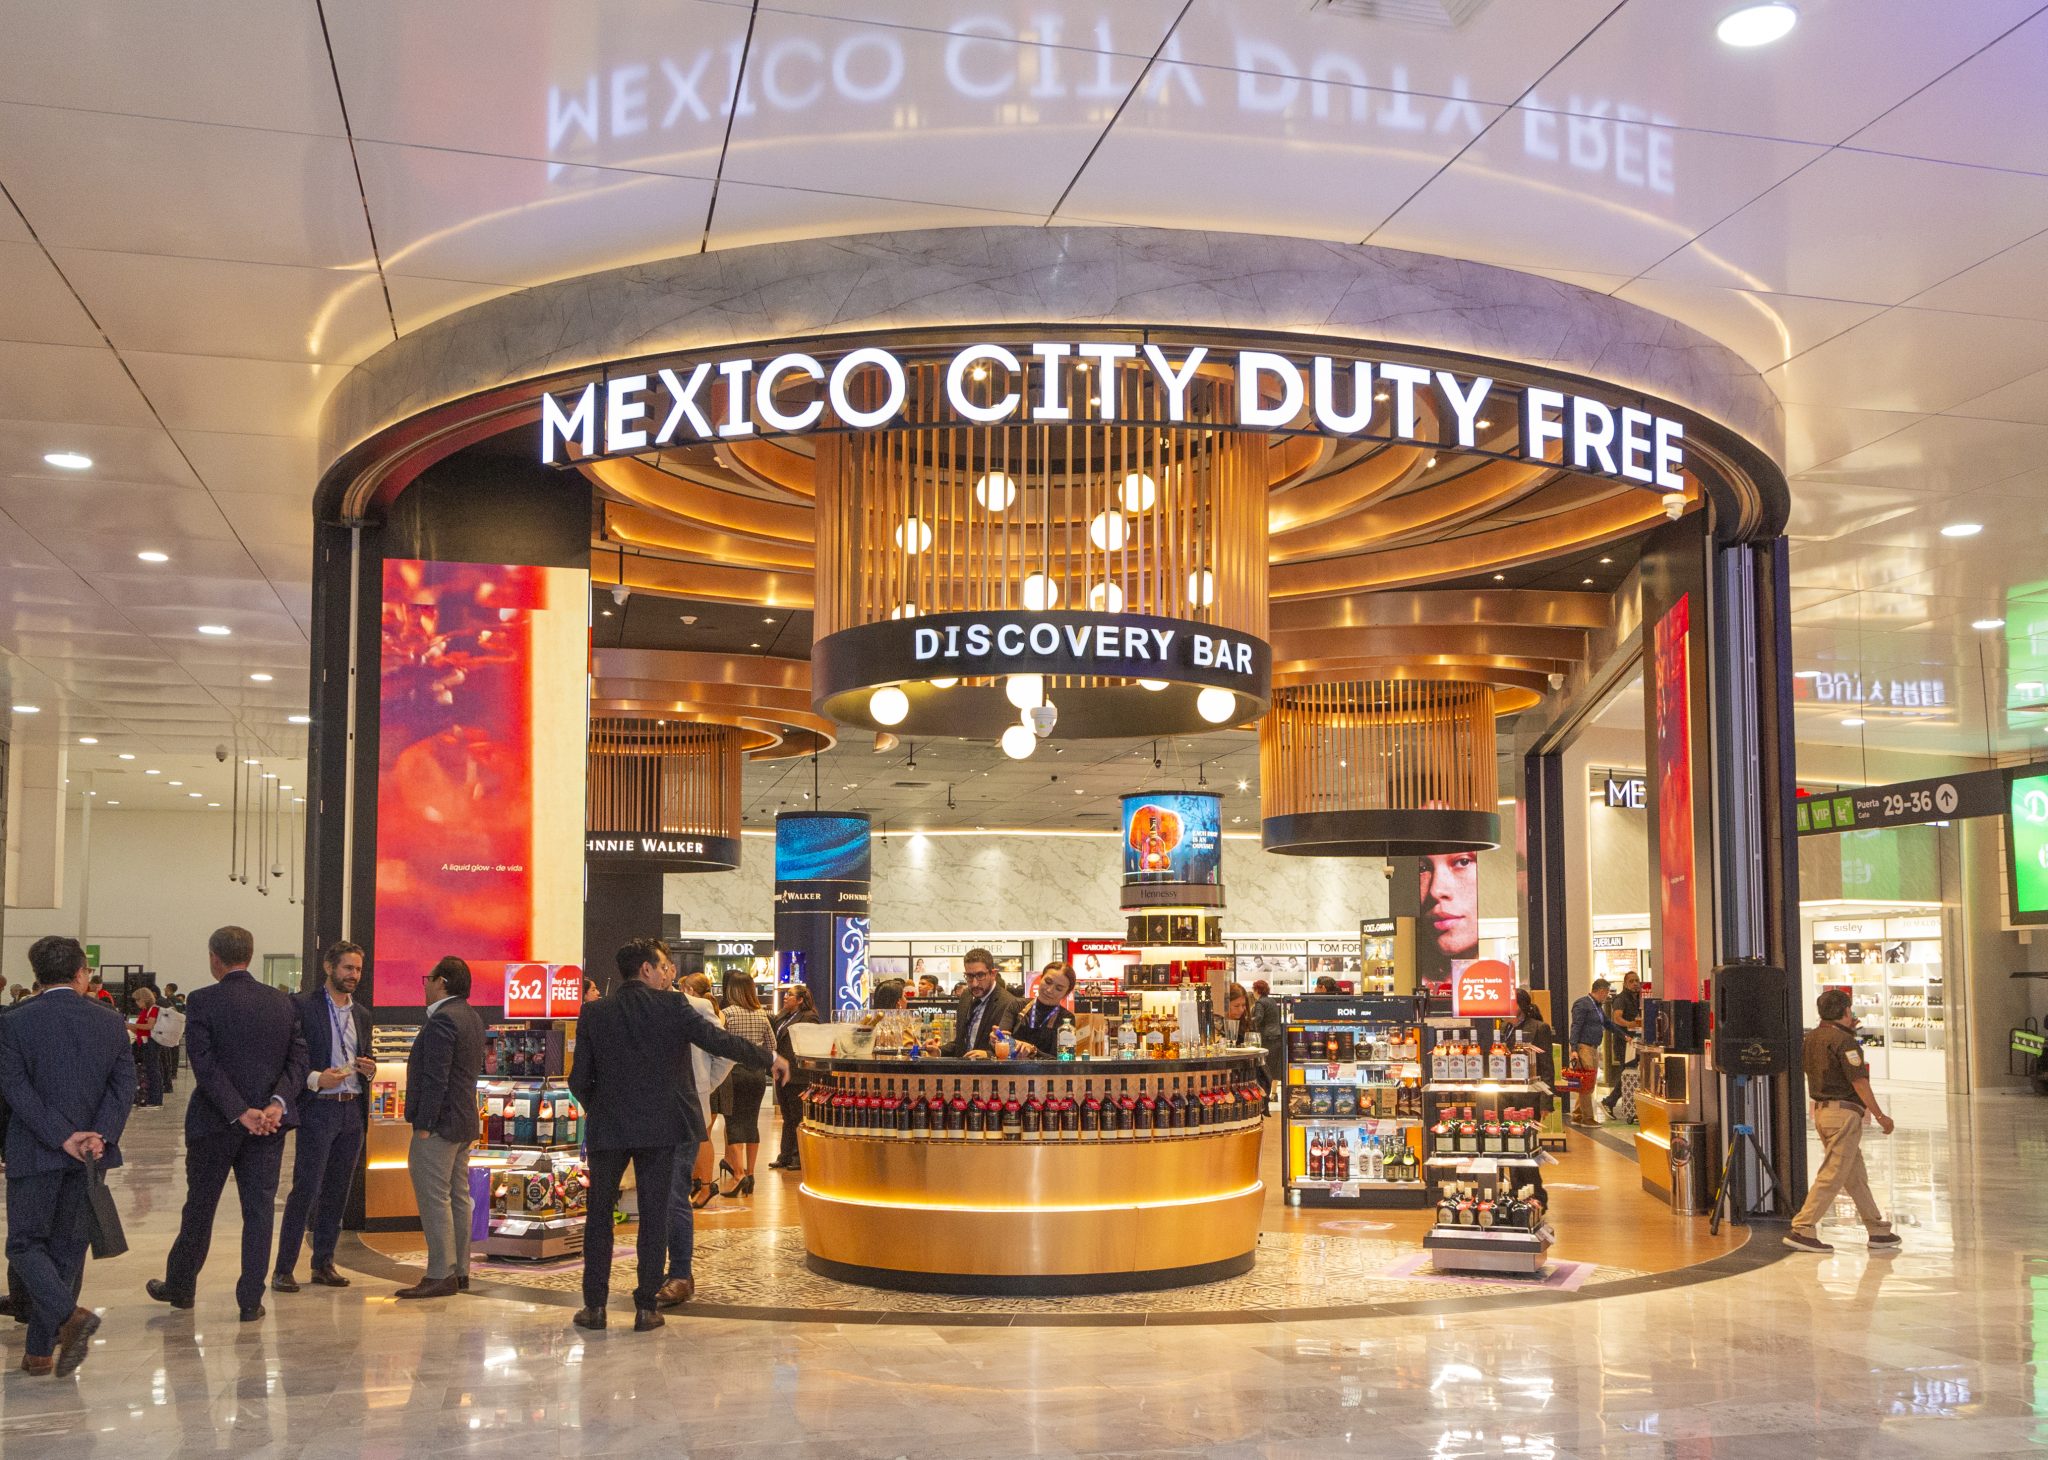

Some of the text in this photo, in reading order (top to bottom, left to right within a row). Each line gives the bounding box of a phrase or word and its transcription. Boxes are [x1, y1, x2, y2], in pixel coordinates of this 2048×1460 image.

[541, 342, 1685, 492] MEXICO CITY DUTY FREE
[915, 622, 1254, 676] DISCOVERY BAR
[1813, 790, 1933, 822] VIP Puerta 29-36
[641, 838, 704, 854] WALKER
[441, 863, 449, 871] A
[449, 863, 471, 872] liquid
[471, 864, 490, 873] glow
[495, 864, 506, 872] de
[507, 864, 523, 872] vida
[787, 892, 822, 900] WALKER
[1140, 889, 1178, 899] Hennessy
[1833, 922, 1863, 933] sisley
[717, 943, 755, 956] DIOR
[1082, 943, 1117, 951] CAROLINA
[1318, 943, 1340, 953] TOM
[567, 978, 576, 987] get
[509, 979, 542, 1000] 3x2
[551, 986, 579, 1001] FREE
[918, 1006, 943, 1014] VODKA
[1337, 1008, 1357, 1016] RON
